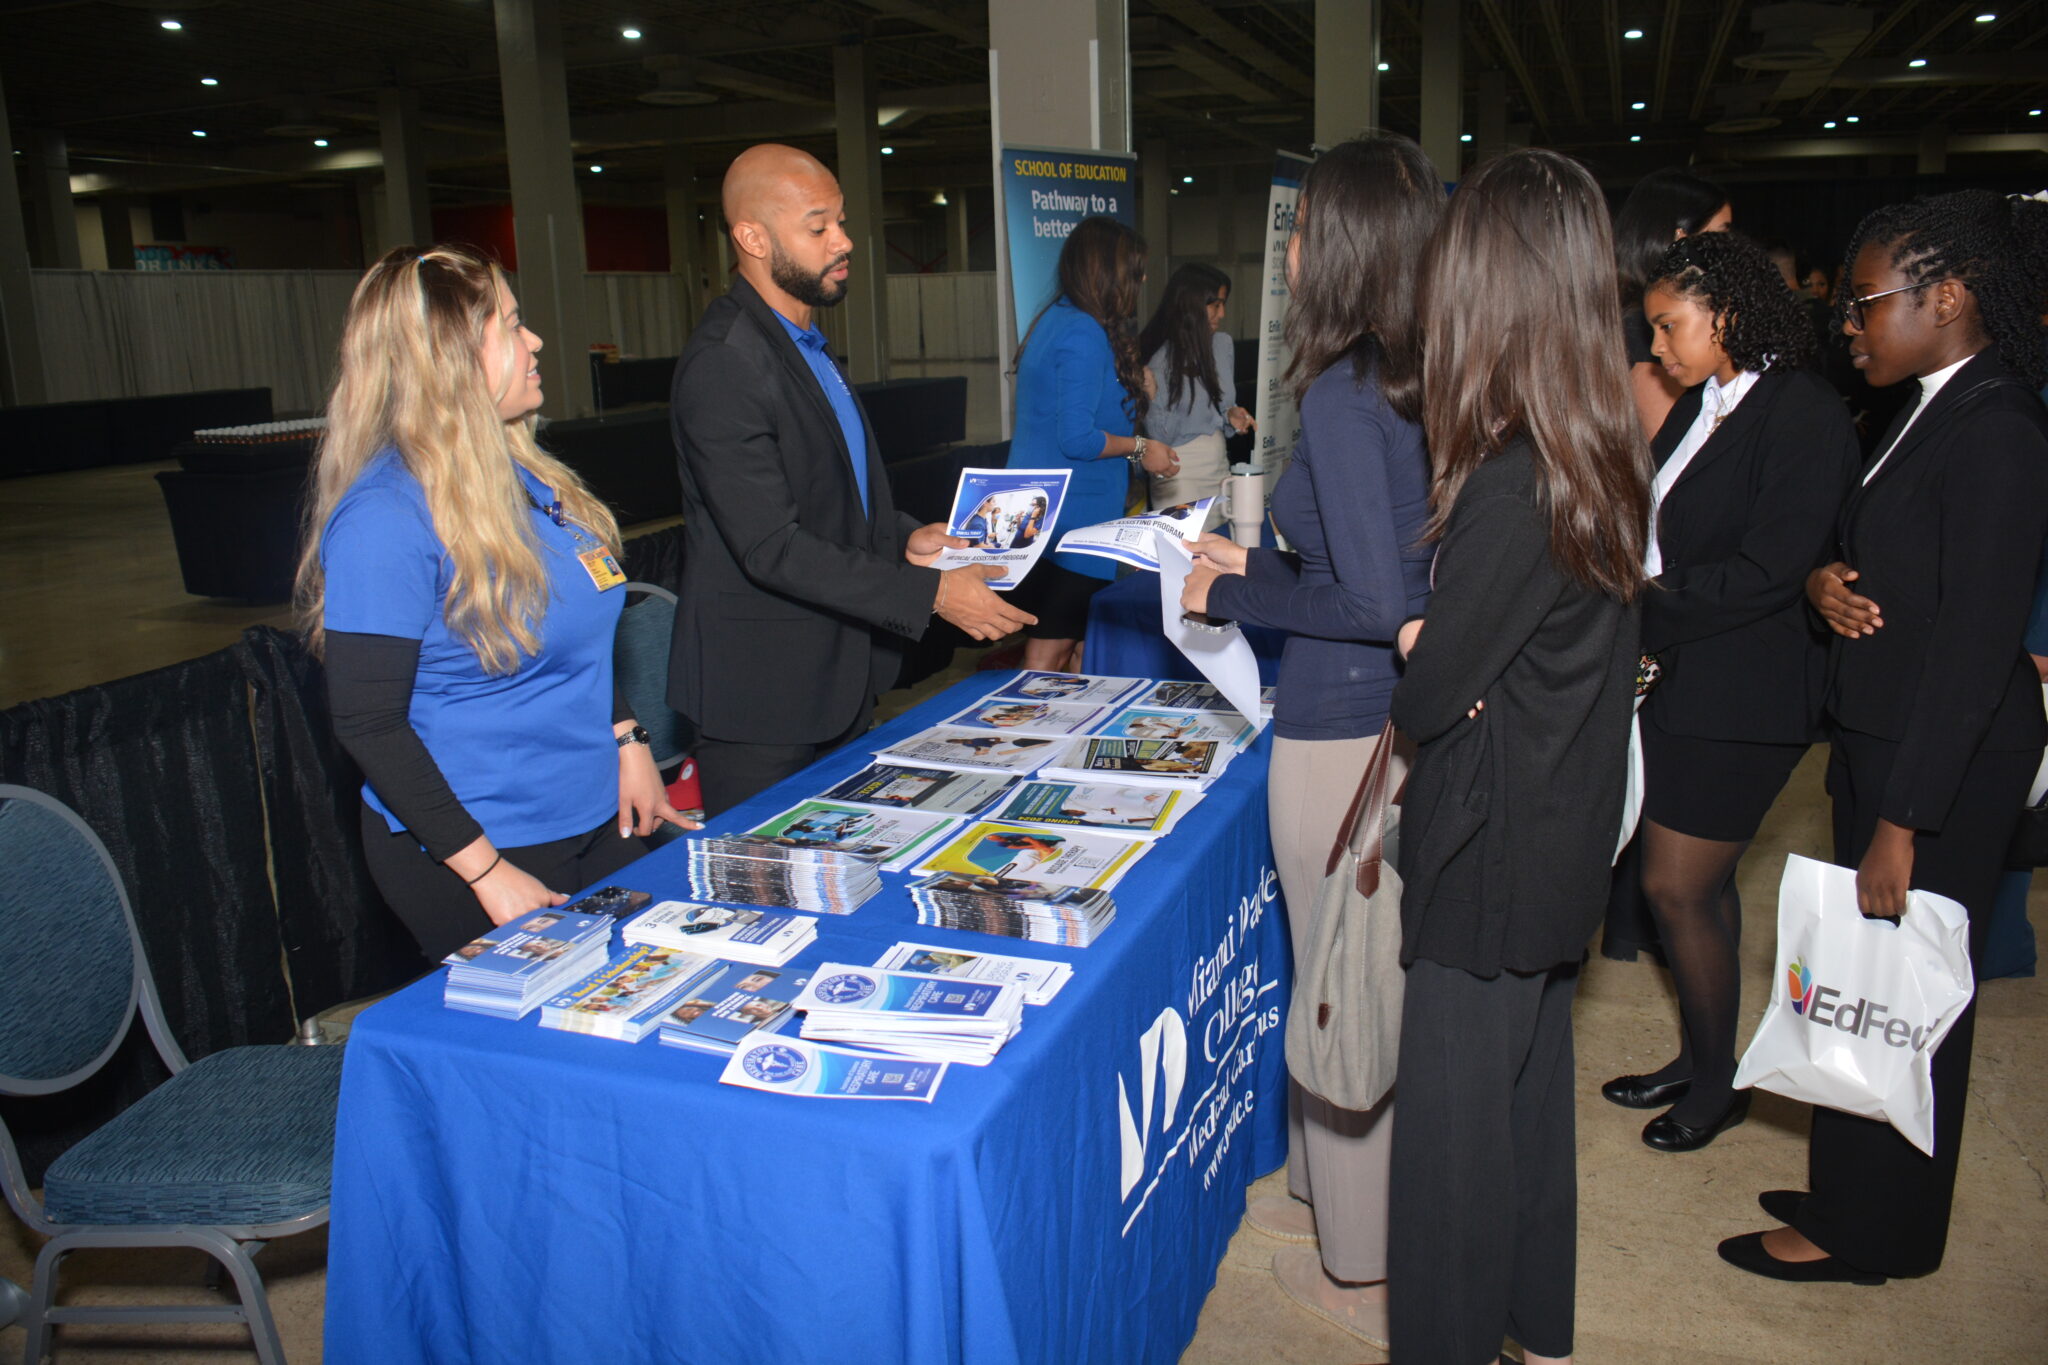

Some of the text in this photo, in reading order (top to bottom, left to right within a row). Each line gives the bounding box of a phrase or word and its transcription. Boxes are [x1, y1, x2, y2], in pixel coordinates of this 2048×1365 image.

[1014, 159, 1127, 182] SCHOOL OF EDUCATION
[1031, 189, 1118, 216] Pathway to a
[1033, 216, 1078, 238] better
[1152, 520, 1185, 540] PROGRAM
[1000, 553, 1029, 561] PROGRAM
[1044, 817, 1081, 825] SPRING
[1059, 845, 1083, 859] THERAPY
[1187, 865, 1278, 1026] Miami Dade
[601, 945, 653, 979] Scholarship?
[908, 980, 939, 1011] RESPIRATORY
[927, 990, 945, 1003] CARE
[846, 1058, 873, 1094] RESPIRATORY
[863, 1070, 881, 1085] CARE
[1189, 1005, 1279, 1168] Medical Caus
[1204, 1089, 1254, 1192] www.mdc.e
